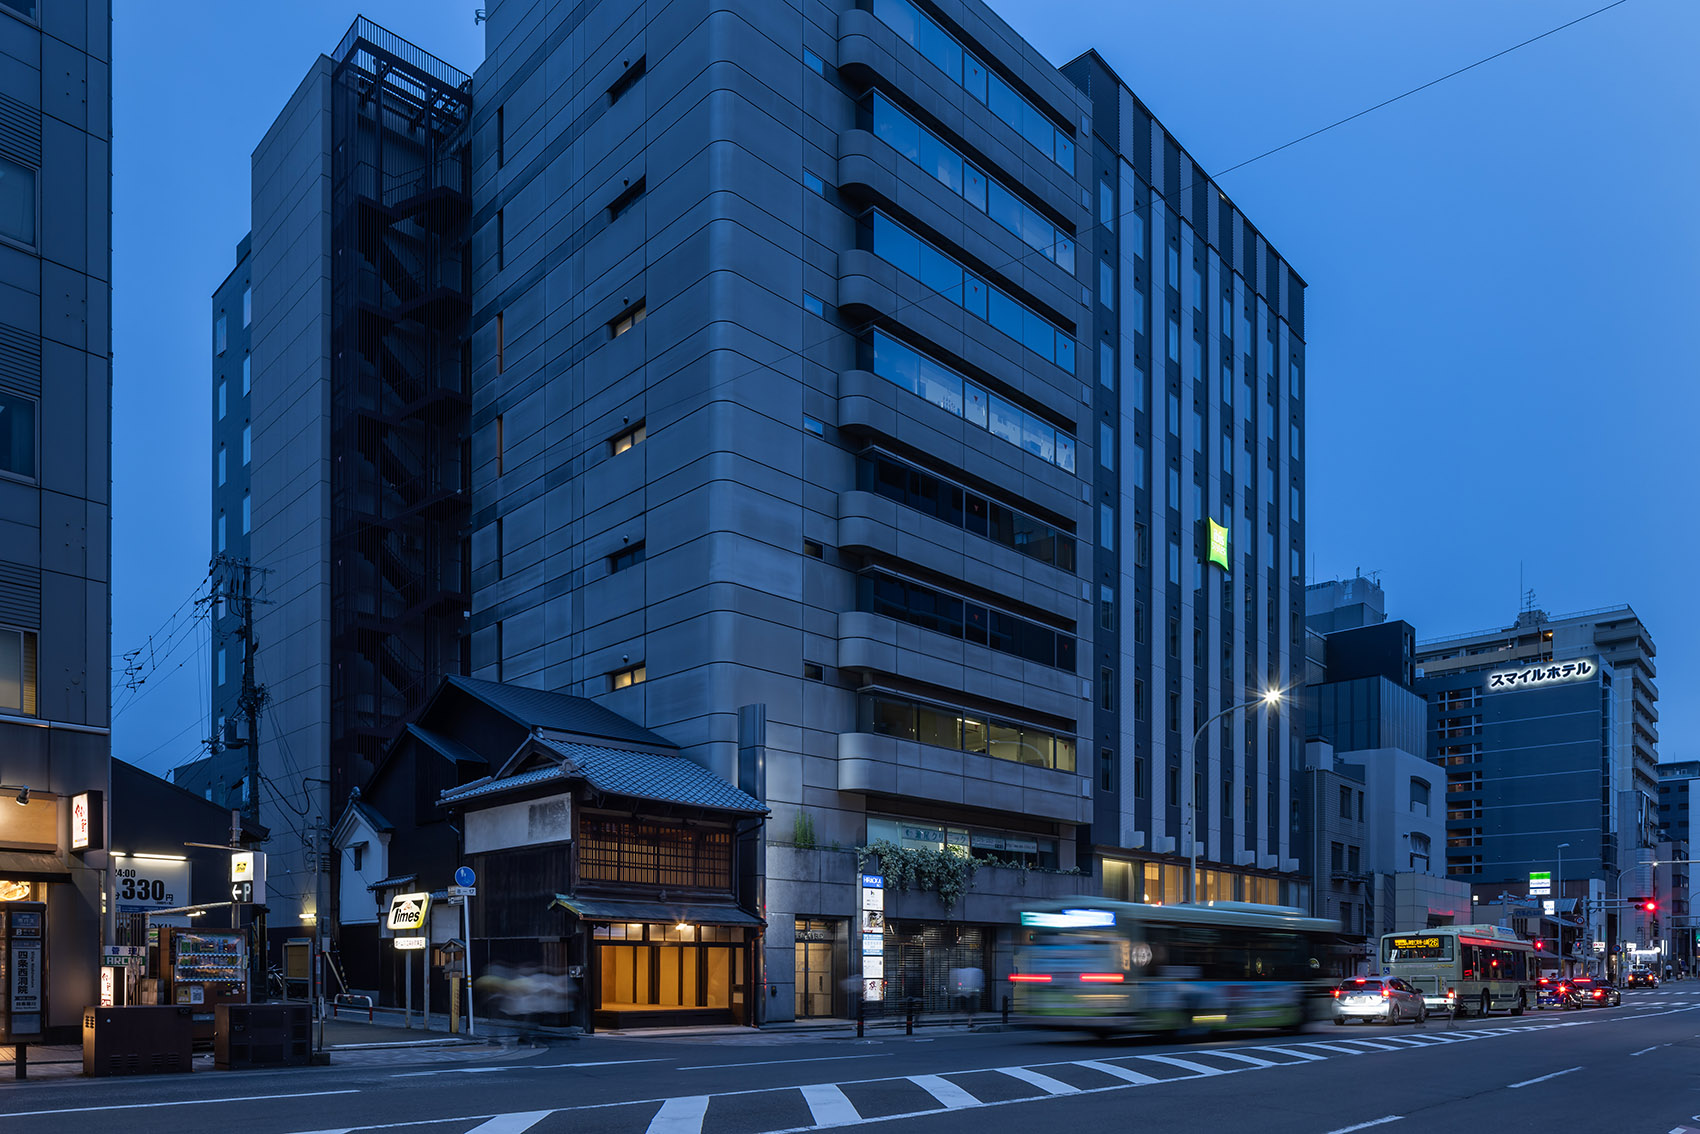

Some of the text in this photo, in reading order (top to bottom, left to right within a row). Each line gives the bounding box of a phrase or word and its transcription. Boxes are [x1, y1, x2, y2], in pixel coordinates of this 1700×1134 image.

[1491, 662, 1592, 687] スマイルホテル
[393, 908, 420, 924] Times
[18, 951, 28, 994] 四条西洞院
